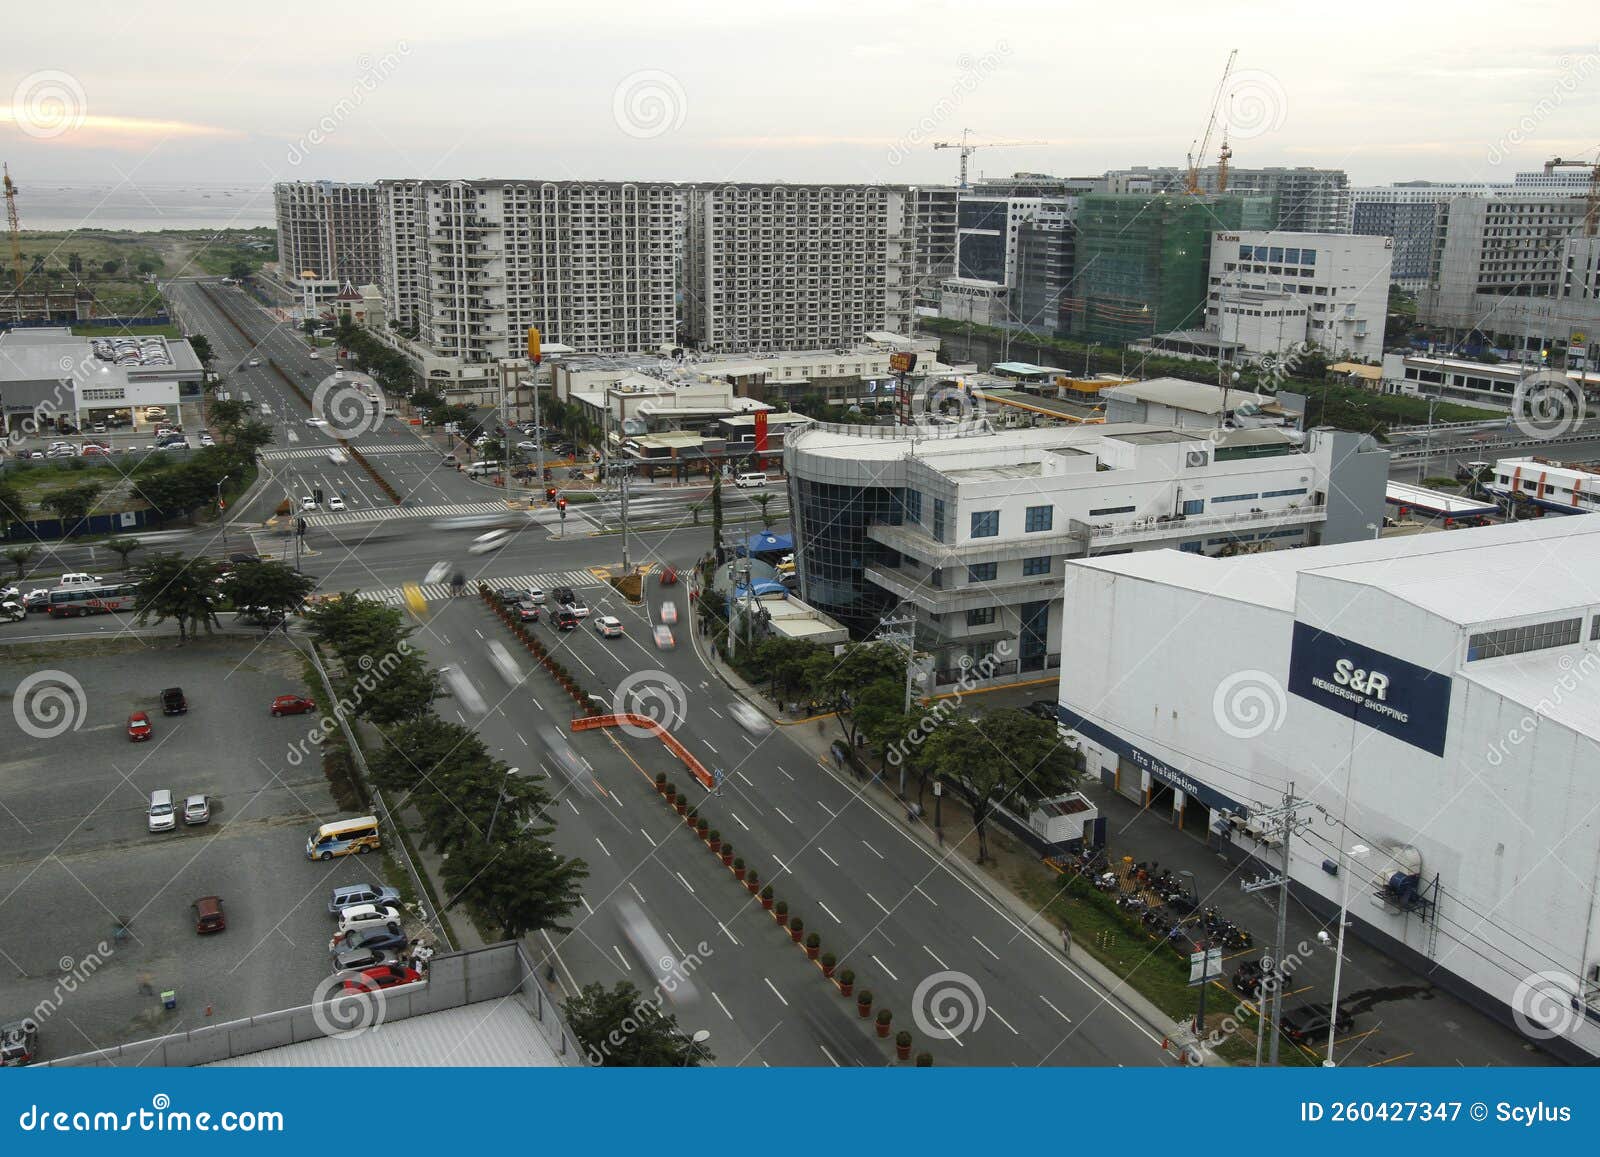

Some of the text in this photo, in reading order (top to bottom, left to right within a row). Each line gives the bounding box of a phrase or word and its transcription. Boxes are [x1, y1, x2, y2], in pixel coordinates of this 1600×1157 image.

[1312, 676, 1409, 723] MEMBERSHIP SHOPPING
[1333, 658, 1390, 701] S&R
[1131, 749, 1198, 794] Tire Installation
